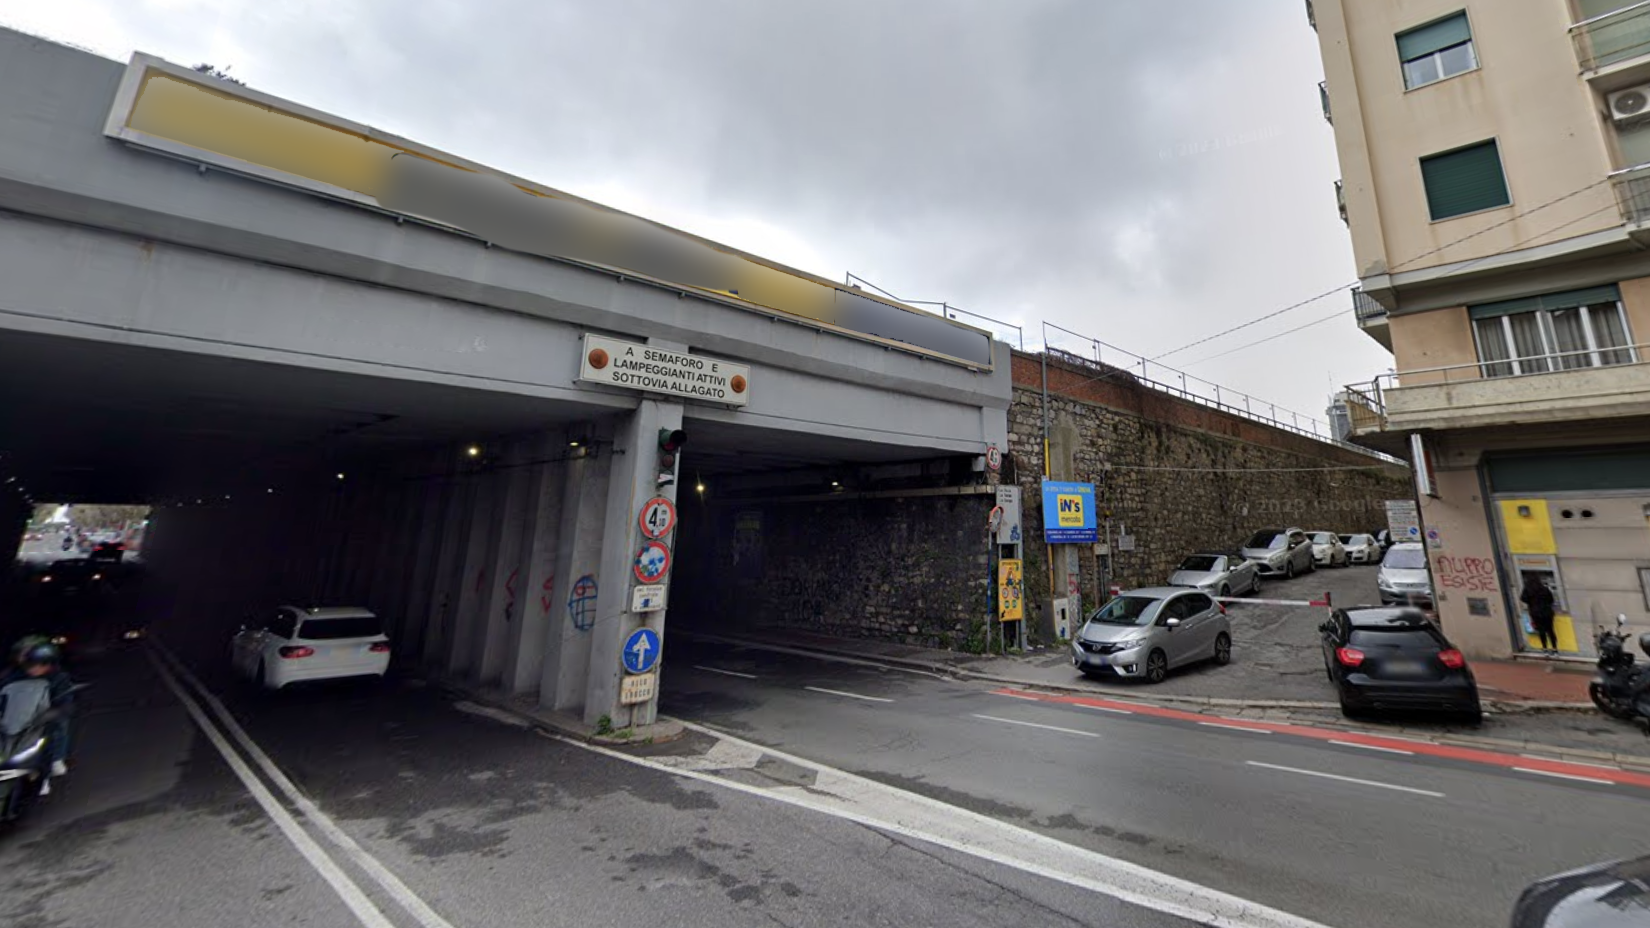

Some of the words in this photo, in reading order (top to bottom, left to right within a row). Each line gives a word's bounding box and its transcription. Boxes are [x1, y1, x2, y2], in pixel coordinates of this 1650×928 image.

[614, 358, 695, 382] LAMPEGGIANTI
[696, 373, 726, 386] ATTIVI
[626, 347, 634, 357] A
[644, 350, 703, 370] SEMAFORO
[712, 363, 718, 373] E
[612, 371, 668, 390] SOTTOVIA
[670, 381, 725, 399] ALLAGATO
